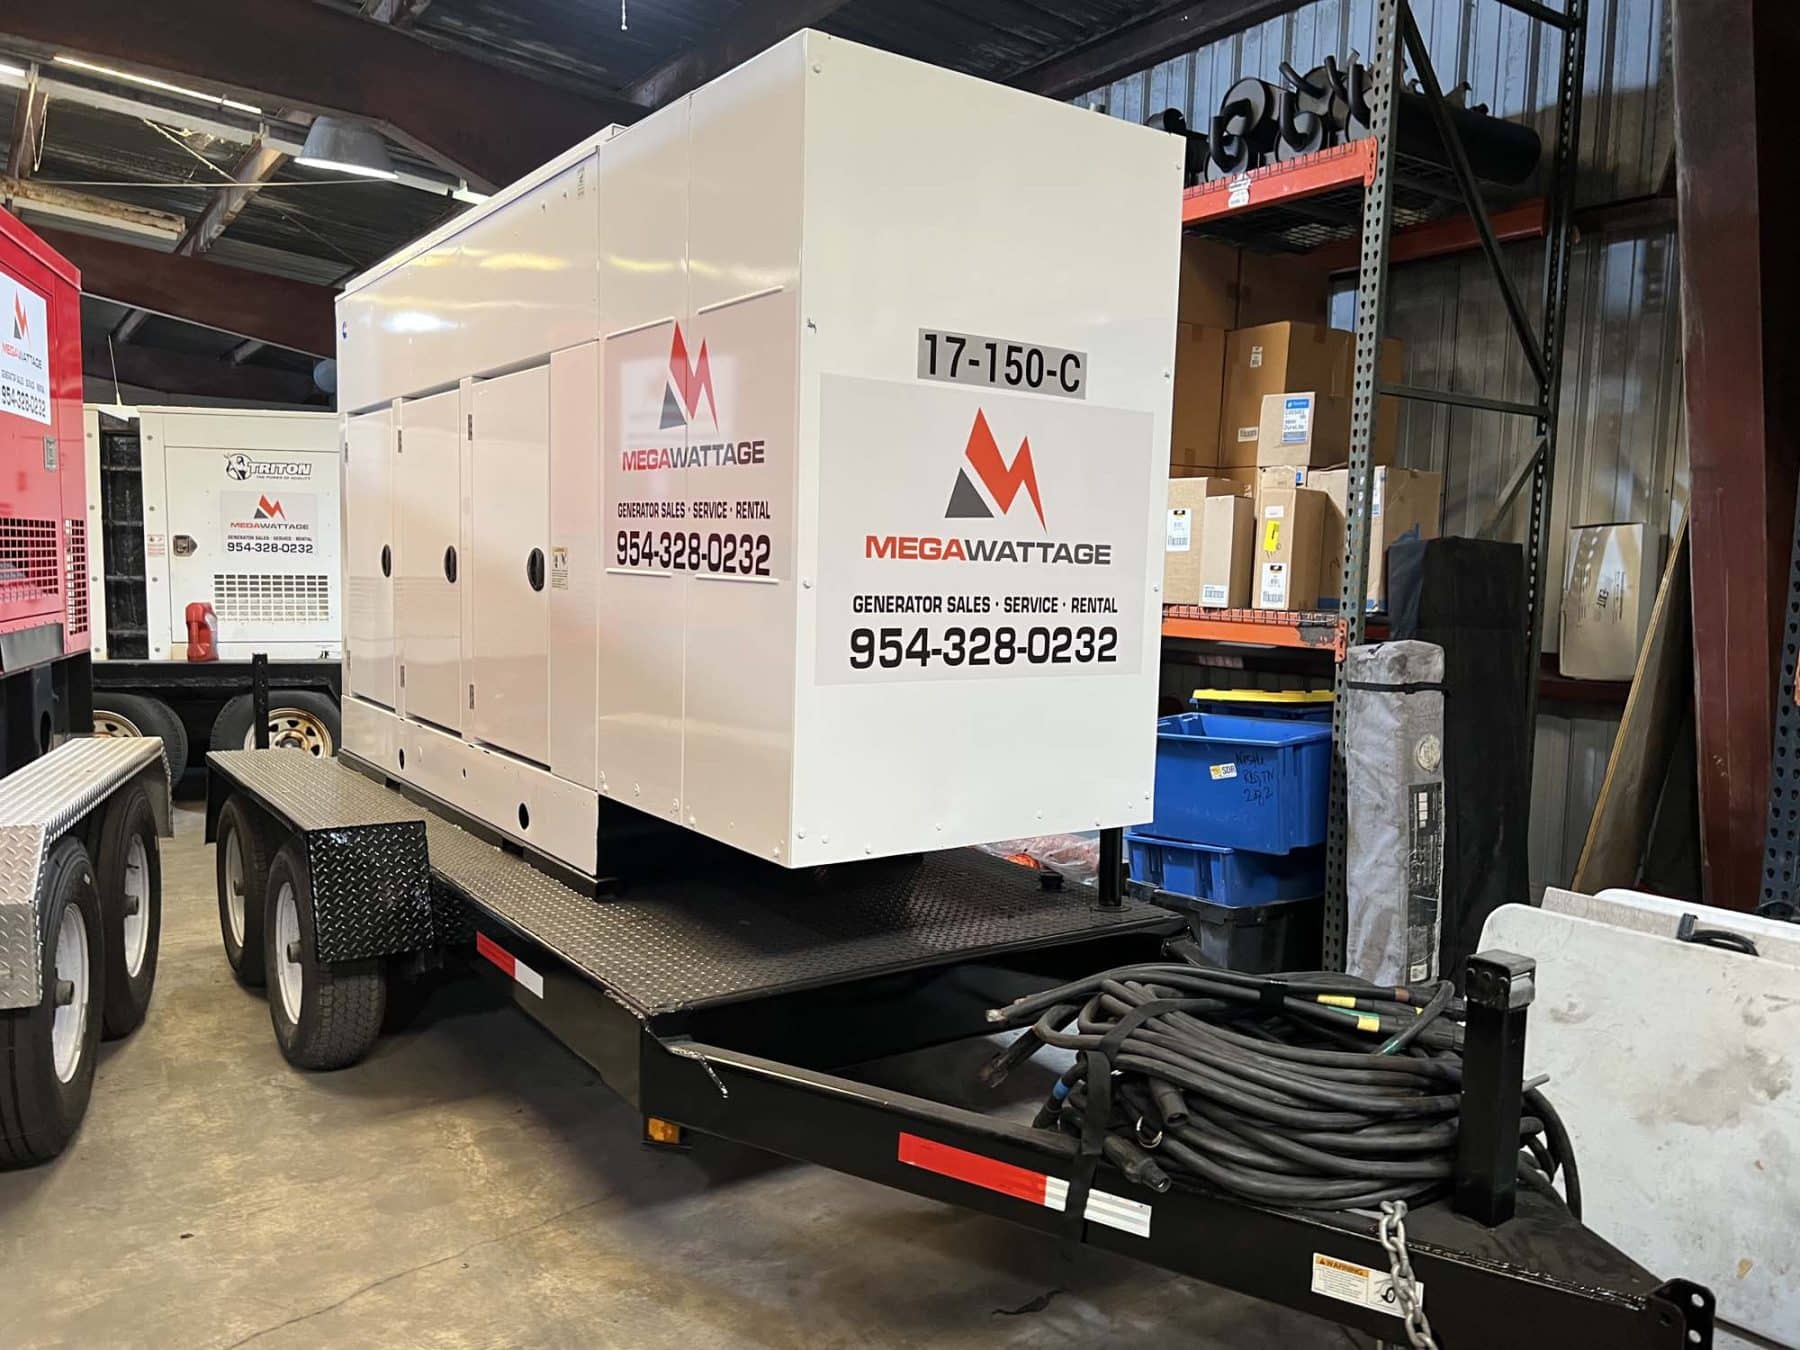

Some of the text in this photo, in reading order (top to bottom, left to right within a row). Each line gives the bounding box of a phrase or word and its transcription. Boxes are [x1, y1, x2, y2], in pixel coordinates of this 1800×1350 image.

[924, 333, 1081, 393] 17-150-C
[621, 440, 765, 471] MEGAWATTAGE
[249, 462, 312, 476] TRITON
[617, 501, 771, 520] GENERATOR SALES SERVICE RENTAL
[230, 522, 309, 530] MEGAWATTAGE
[227, 542, 313, 554] 954-328-0232
[616, 530, 771, 576] 954-328-0232
[865, 535, 1112, 566] MEGAWATTAGE
[853, 595, 1118, 614] GENERATOR SALES SERVICE RENTAL
[850, 626, 1119, 670] 954-328-0232
